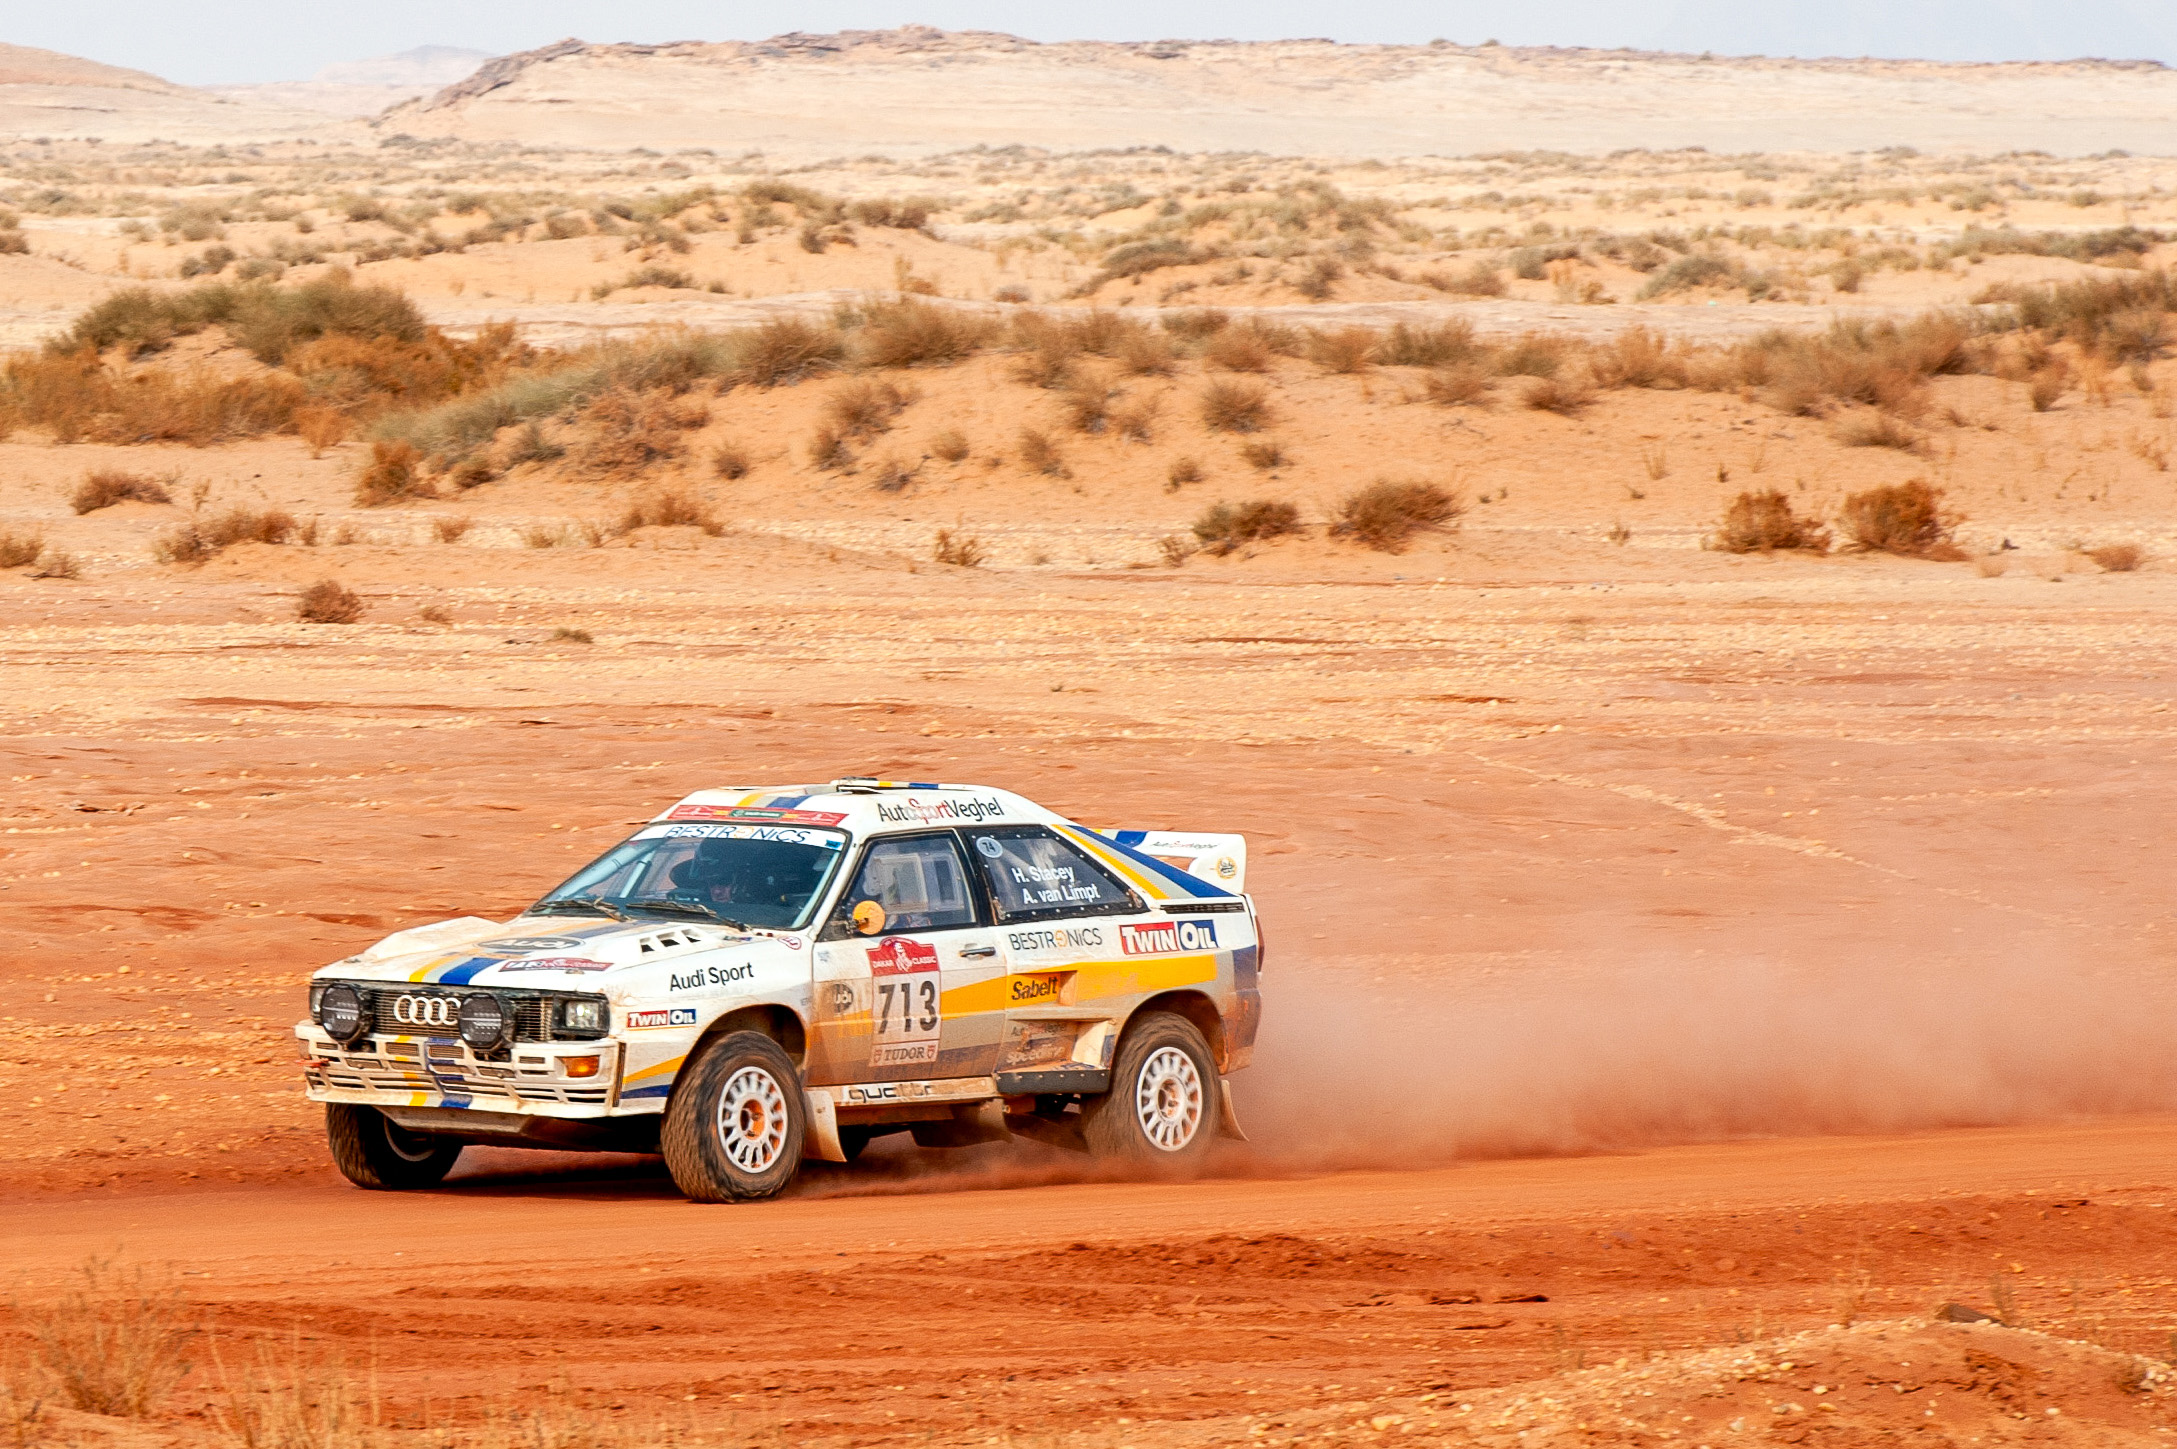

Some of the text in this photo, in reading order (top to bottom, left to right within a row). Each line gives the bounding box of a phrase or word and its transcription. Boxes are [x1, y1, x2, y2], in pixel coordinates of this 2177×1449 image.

[1011, 865, 1075, 886] H. Stacey
[1021, 883, 1102, 904] A. van Limpt
[911, 956, 937, 965] CLASSIC
[669, 962, 755, 992] Audi Sport
[1011, 976, 1058, 1001] Sabelt
[878, 980, 938, 1034] 713
[884, 1046, 925, 1061] TUDOR
